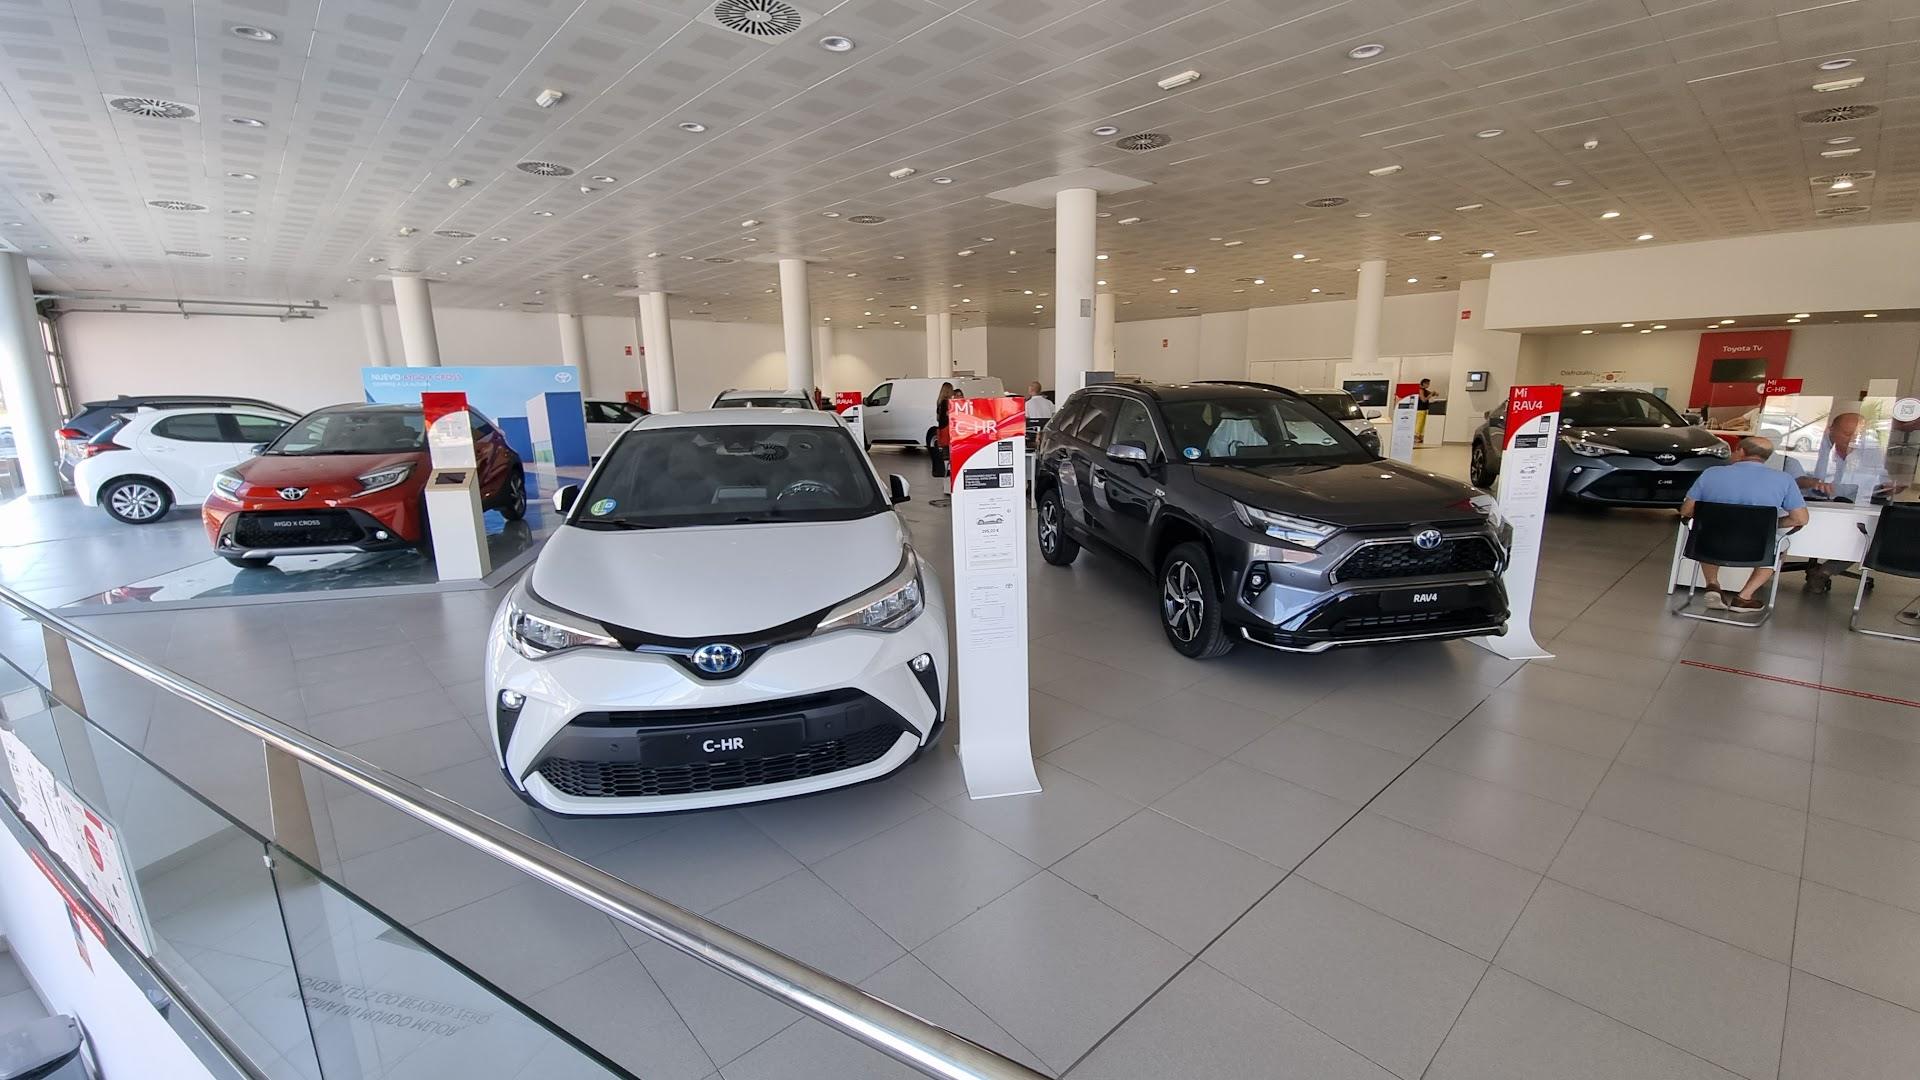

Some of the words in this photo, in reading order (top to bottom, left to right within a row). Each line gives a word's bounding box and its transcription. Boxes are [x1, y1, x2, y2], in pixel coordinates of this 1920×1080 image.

[1722, 345, 1751, 353] Toyota
[371, 373, 401, 381] NUEVO
[1514, 387, 1528, 398] Mi
[954, 401, 974, 415] Mi
[1513, 400, 1544, 411] RAV4
[955, 420, 998, 436] C-HR
[1413, 593, 1438, 603] RAV4
[703, 737, 744, 752] C-HR
